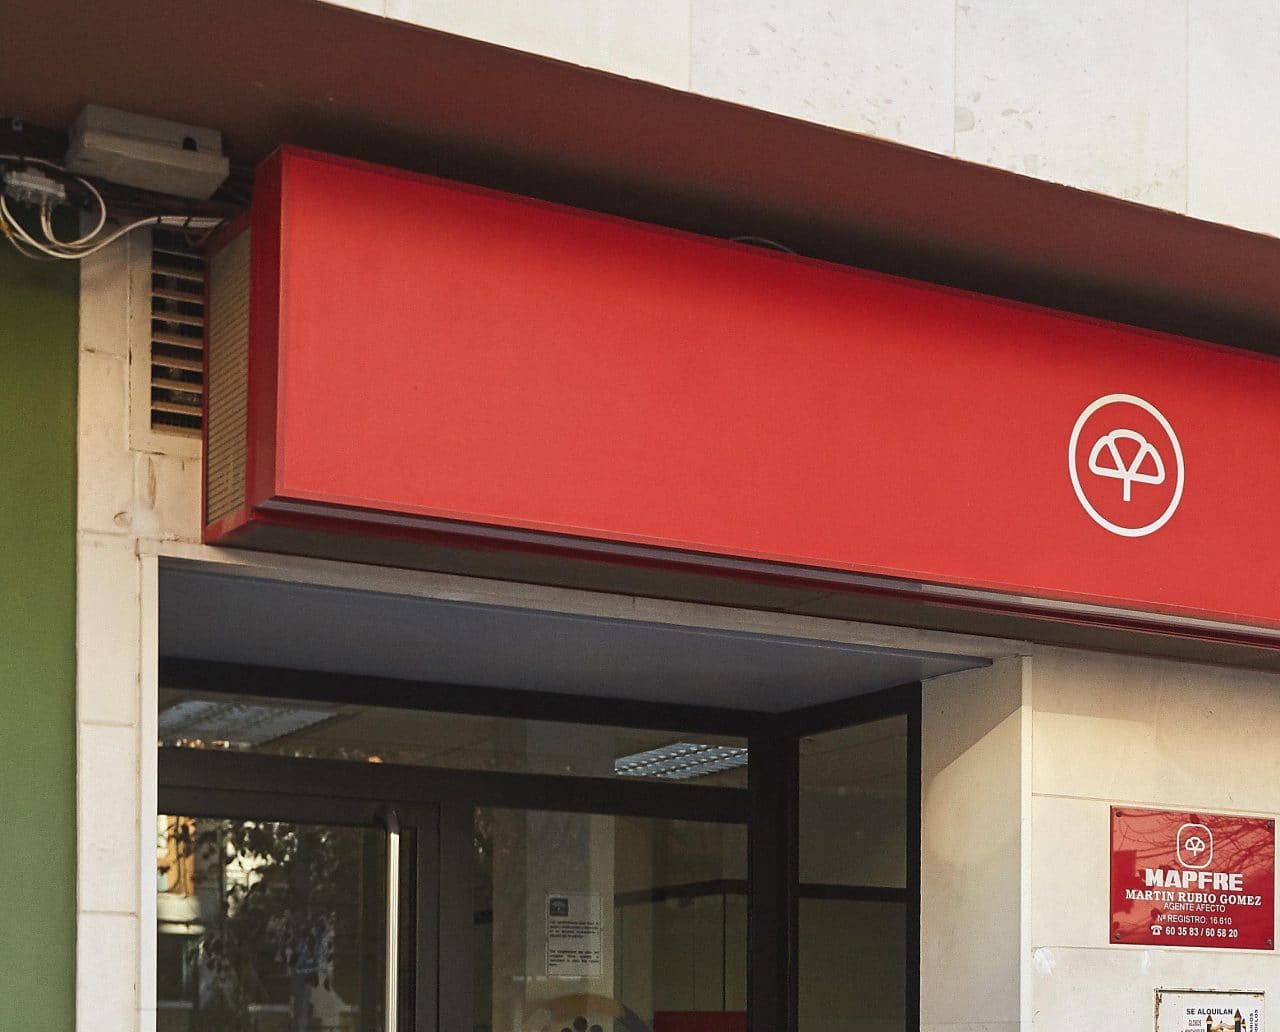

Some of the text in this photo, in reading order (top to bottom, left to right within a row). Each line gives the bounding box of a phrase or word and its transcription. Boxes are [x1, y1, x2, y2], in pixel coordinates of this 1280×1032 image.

[1145, 868, 1244, 892] MAPFRE
[1125, 889, 1262, 906] MARTIN RUBIO GOMEZ
[1164, 902, 1226, 913] AGENTE AFECTO
[1165, 926, 1176, 935] 60
[1177, 927, 1187, 935] 35
[1189, 928, 1199, 936] 83
[1205, 928, 1215, 936] 60
[1228, 929, 1238, 938] 20
